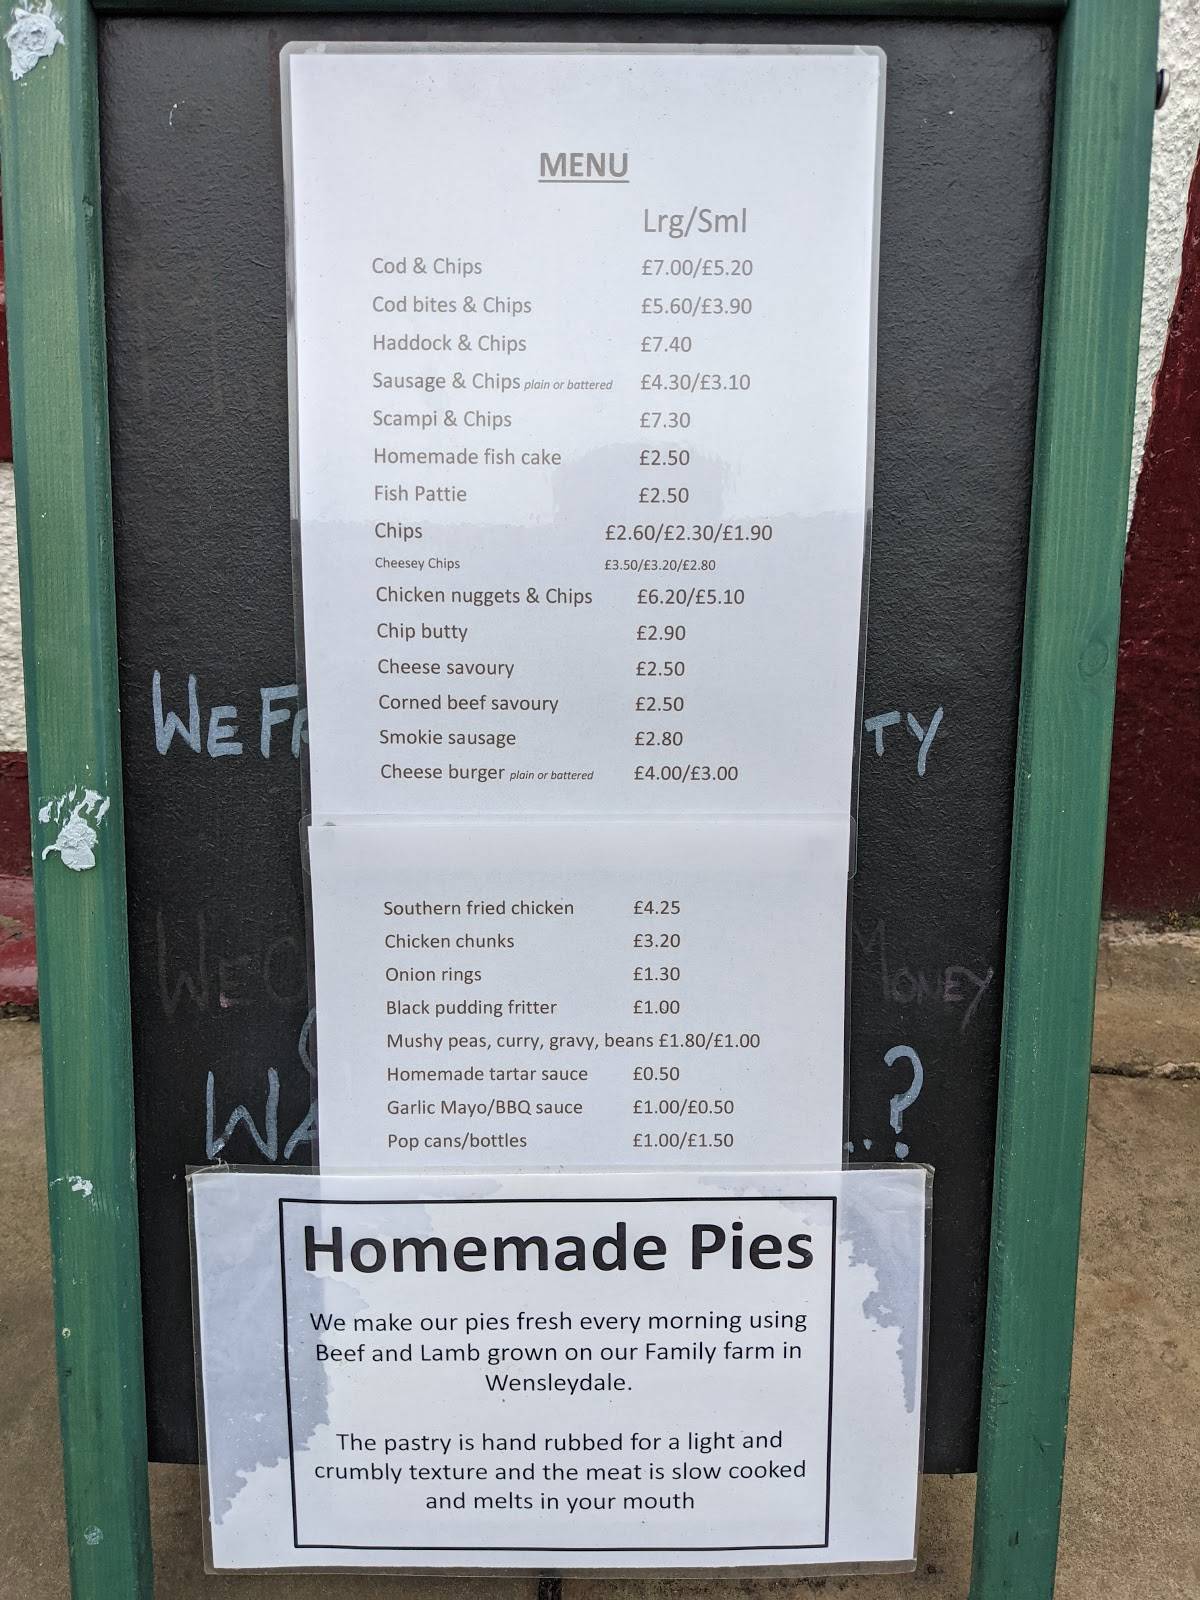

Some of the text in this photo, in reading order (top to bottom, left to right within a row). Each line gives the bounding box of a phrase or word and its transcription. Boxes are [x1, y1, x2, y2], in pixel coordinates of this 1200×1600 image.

[538, 153, 630, 183] MENU
[645, 206, 746, 239] Lrg/Sml
[372, 257, 482, 278] Cod & Chips
[641, 258, 753, 279] £7.00/£5.20
[373, 296, 532, 317] Cod bites & Chips
[641, 296, 752, 317] £5.60/£3.90
[374, 333, 526, 355] Haddock & Chips
[641, 336, 692, 352] £7.40
[373, 372, 614, 394] Sausage & Chips plain or battered
[640, 372, 750, 393] £4.30/£3.10
[373, 410, 511, 430] Scampi & Chips
[640, 412, 690, 428] £7.30
[375, 448, 561, 465] Homemade fish cake
[640, 450, 690, 466] £2.50
[375, 484, 466, 502] Fish Pattie
[639, 488, 689, 503] £2.50
[375, 522, 422, 542] Chips
[605, 523, 772, 543] £2.60/£2.30/£1.90
[375, 557, 460, 571] Cheesey Chips
[605, 559, 715, 572] £3.50/£3.20/£2.80
[376, 586, 592, 607] Chicken nuggets & Chips
[637, 587, 744, 607] £6.20/£5.10
[377, 622, 468, 642] Chip butty
[637, 625, 685, 640] £2.90
[378, 658, 514, 679] Cheese savoury
[636, 661, 685, 676] £2.50
[379, 694, 558, 714] Corned beef savoury
[636, 697, 684, 711] £2.50
[380, 729, 516, 748] Smokie sausage
[635, 731, 683, 746] £2.80
[381, 763, 442, 779] Cheese
[449, 764, 505, 782] burger
[510, 770, 534, 782] plain
[551, 771, 594, 780] battered
[634, 764, 738, 783] £4.00/£3.00
[384, 900, 573, 915] Southern fried chicken
[634, 901, 680, 914] £4.25
[385, 933, 514, 948] Chicken chunks
[633, 934, 680, 947] £3.20
[386, 967, 481, 984] Onion rings
[633, 967, 680, 981] £1.30
[387, 1000, 557, 1018] Black pudding fritter
[633, 1000, 680, 1014] £1.00
[388, 1032, 760, 1051] Mushy peas, curry, gravy, beans £1.80/£1.00
[388, 1066, 588, 1081] Homemade tartar sauce
[633, 1067, 679, 1081] £0.50
[388, 1099, 582, 1118] Garlic Mayo/BBQ sauce
[633, 1098, 734, 1117] £1.00/£0.50
[389, 1132, 527, 1151] Pop cans/bottles
[633, 1132, 733, 1150] £1.00/£1.50
[305, 1222, 813, 1273] Homemade Pies
[310, 1311, 807, 1335] We make our pies fresh every morning using
[317, 1341, 801, 1365] Beef and Lamb grown on our Family farm in
[485, 1373, 631, 1395] Wensleydale.
[336, 1430, 782, 1455] The pastry is hand rubbed for a light and
[315, 1460, 805, 1484] crumbly texture and the meat is slow cooked
[426, 1492, 694, 1514] and melts in your mouth
